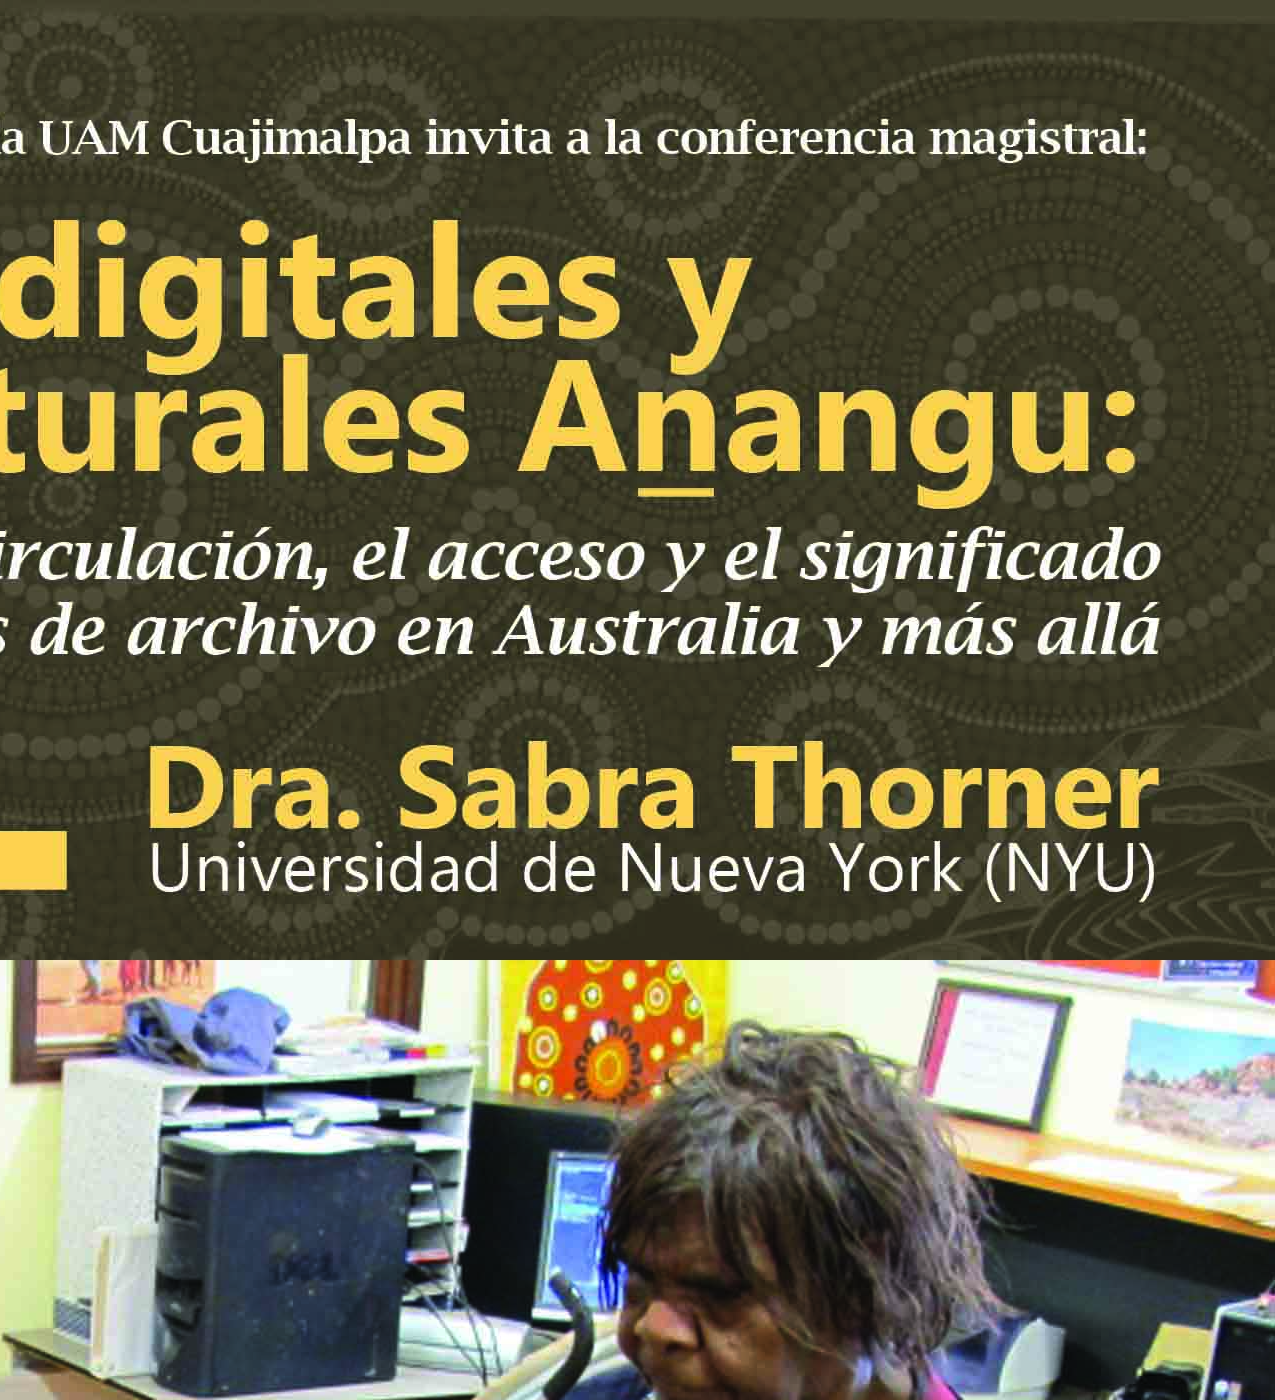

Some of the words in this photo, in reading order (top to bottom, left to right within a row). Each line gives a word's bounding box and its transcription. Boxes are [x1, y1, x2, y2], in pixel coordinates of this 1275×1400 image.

[38, 118, 151, 157] UAM
[161, 117, 413, 165] Cuajimalpa
[424, 117, 554, 156] invita
[565, 127, 593, 156] a
[603, 117, 644, 156] la
[656, 117, 917, 156] conferencia
[928, 117, 1147, 165] magistral:
[665, 256, 753, 377] y
[351, 525, 411, 582] el
[427, 540, 646, 582] acceso
[659, 541, 707, 594] y
[723, 525, 783, 582] el
[798, 524, 1162, 595] significado
[29, 600, 106, 657] de
[126, 600, 377, 657] archivo
[396, 615, 475, 657] en
[491, 600, 801, 657] Australia
[816, 616, 864, 669] y
[880, 600, 1018, 657] más
[1036, 600, 1161, 657] allá
[149, 744, 361, 831] Dra.
[399, 739, 695, 831] Sabra
[730, 739, 1160, 831] Thorner
[151, 839, 498, 894] Universidad
[522, 839, 597, 894] de
[620, 841, 806, 894] Nueva
[827, 839, 964, 894] York
[985, 841, 1156, 904] (NYU)
